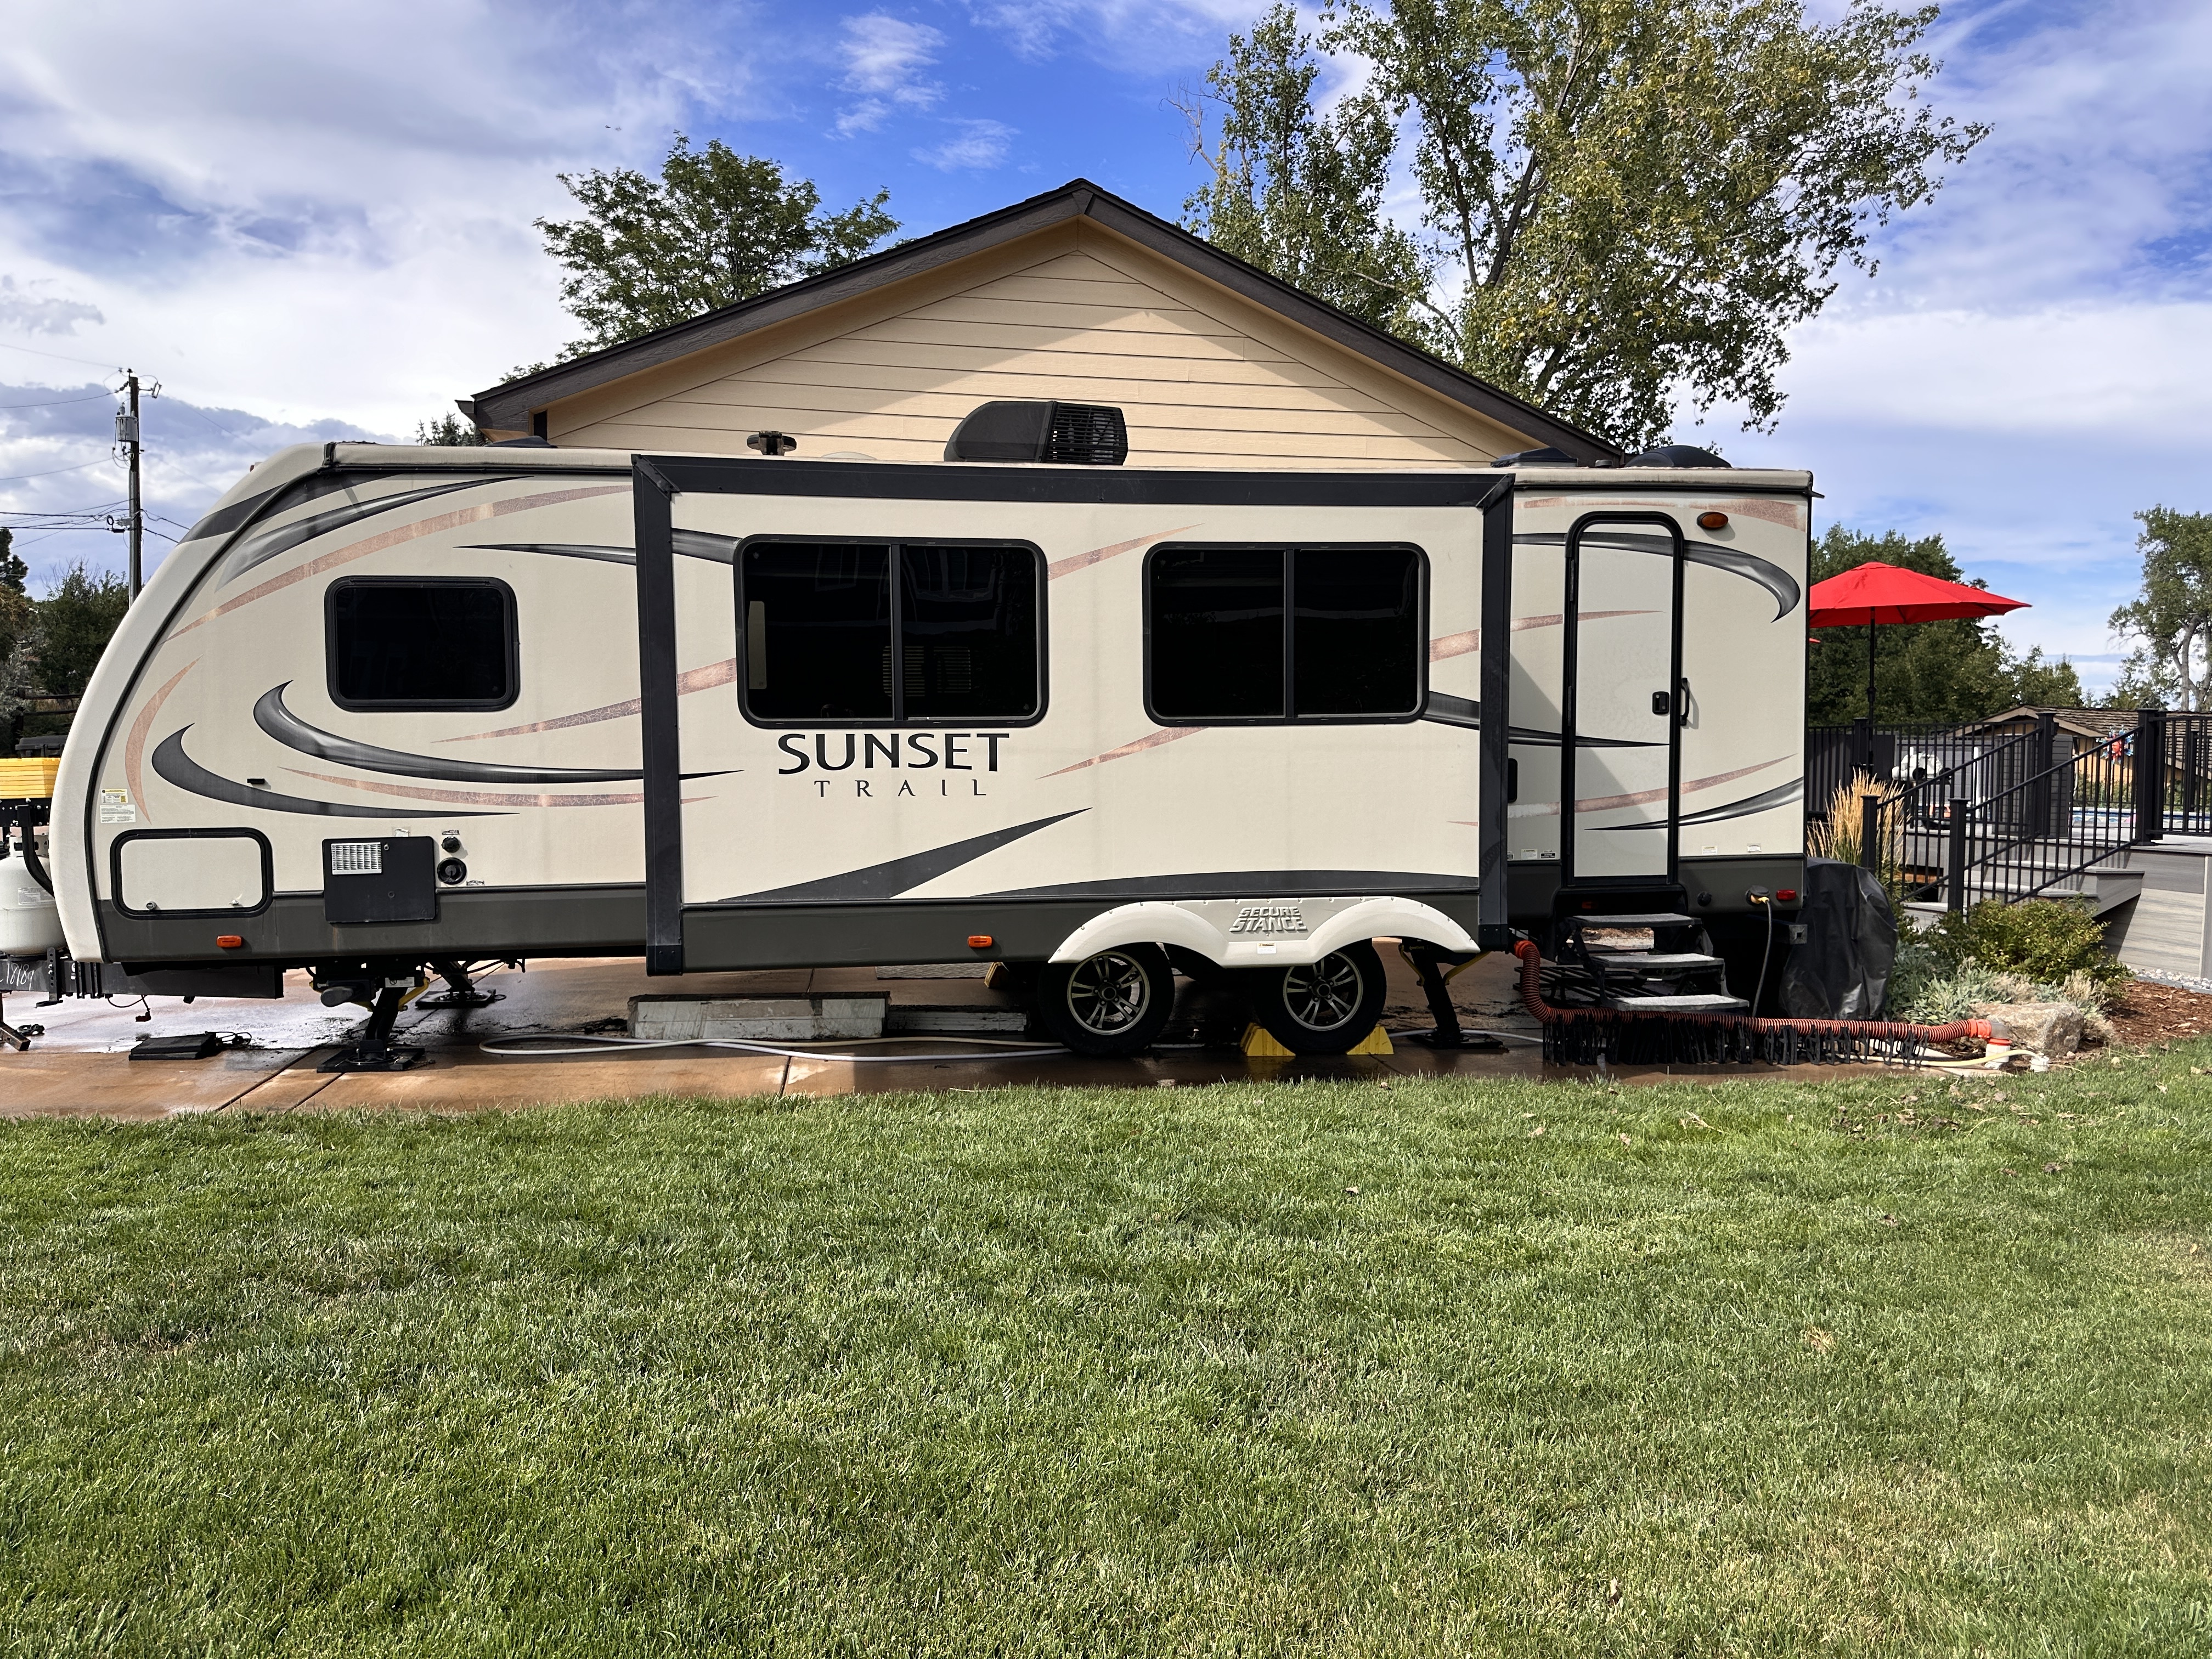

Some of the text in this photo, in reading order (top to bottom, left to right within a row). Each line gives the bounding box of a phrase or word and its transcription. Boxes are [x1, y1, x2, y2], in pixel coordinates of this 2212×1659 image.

[778, 732, 1010, 775] SUNSET
[814, 779, 987, 798] TRAIL
[1238, 906, 1301, 918] SECURE
[1229, 917, 1308, 932] STANCE
[0, 963, 35, 991] 18189
